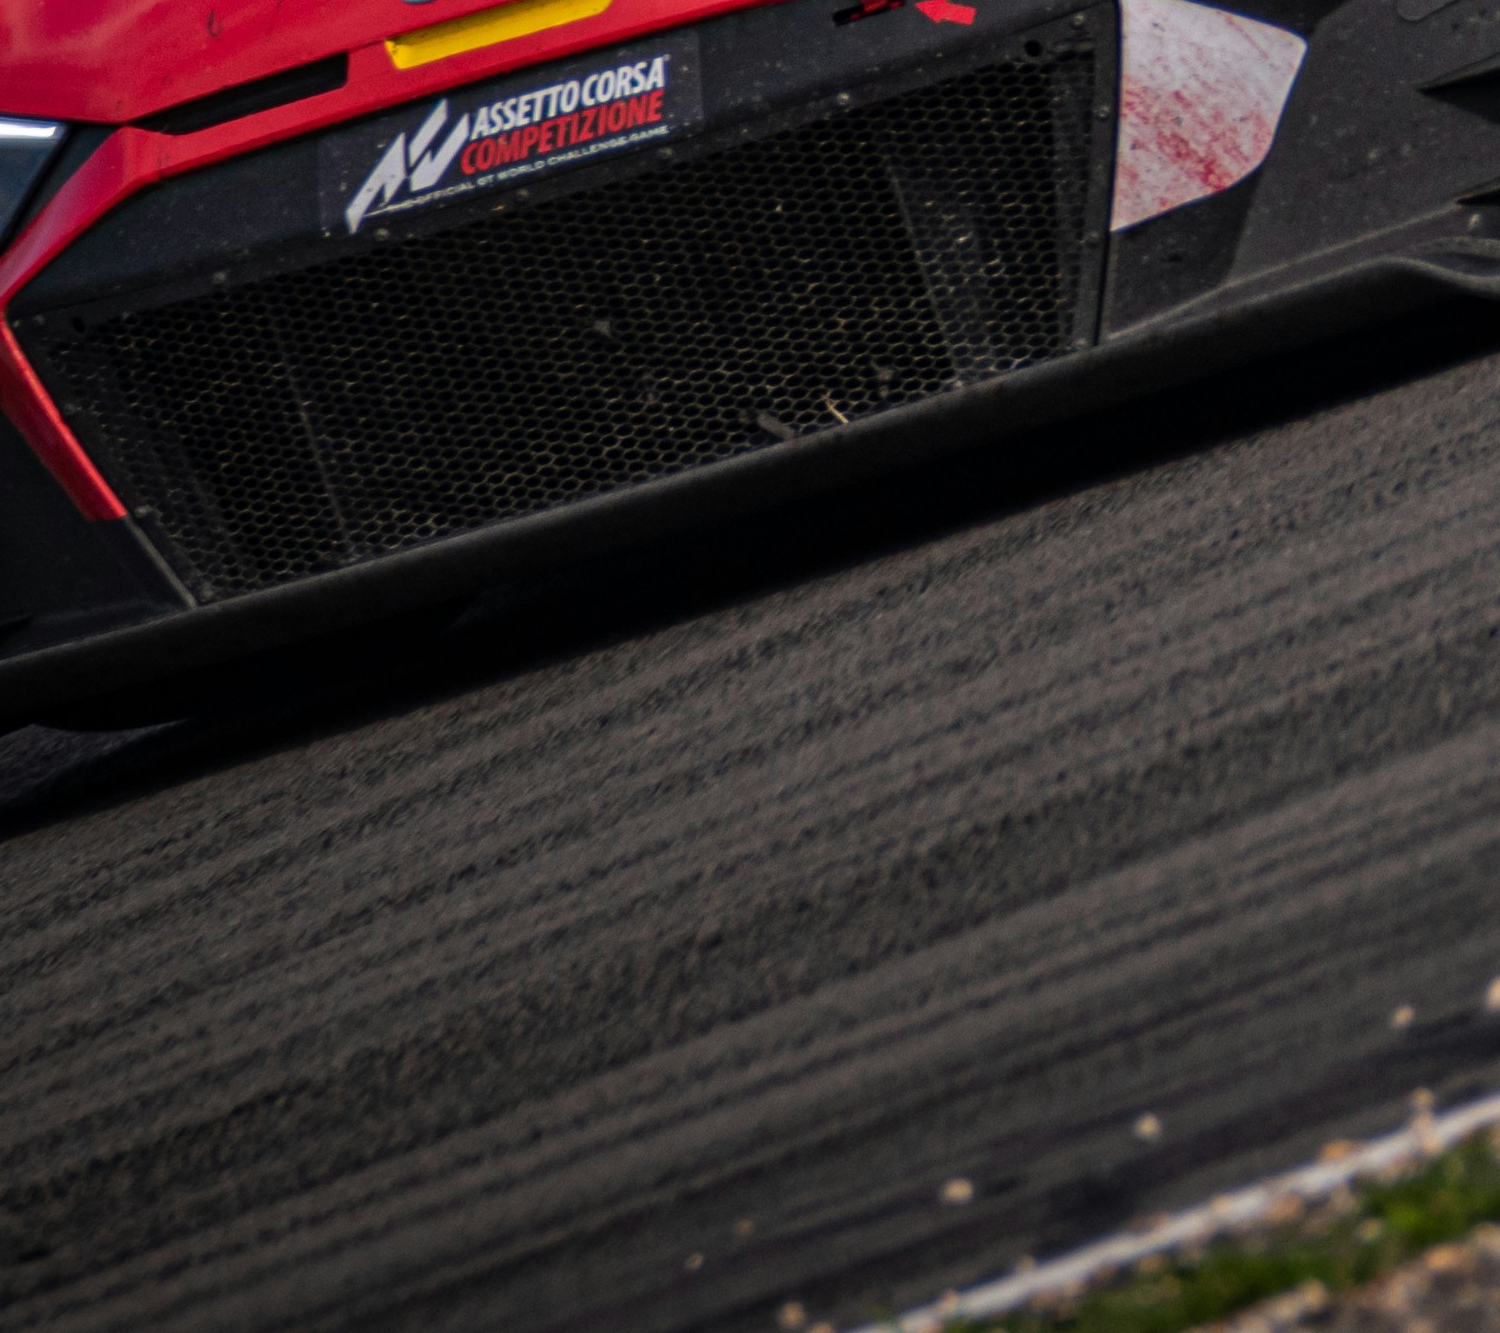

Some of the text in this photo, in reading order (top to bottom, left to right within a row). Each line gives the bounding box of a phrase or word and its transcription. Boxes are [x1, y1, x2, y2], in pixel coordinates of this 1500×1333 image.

[460, 89, 666, 175] COMPETIZIONE
[470, 55, 665, 141] ASSETTO CORSA
